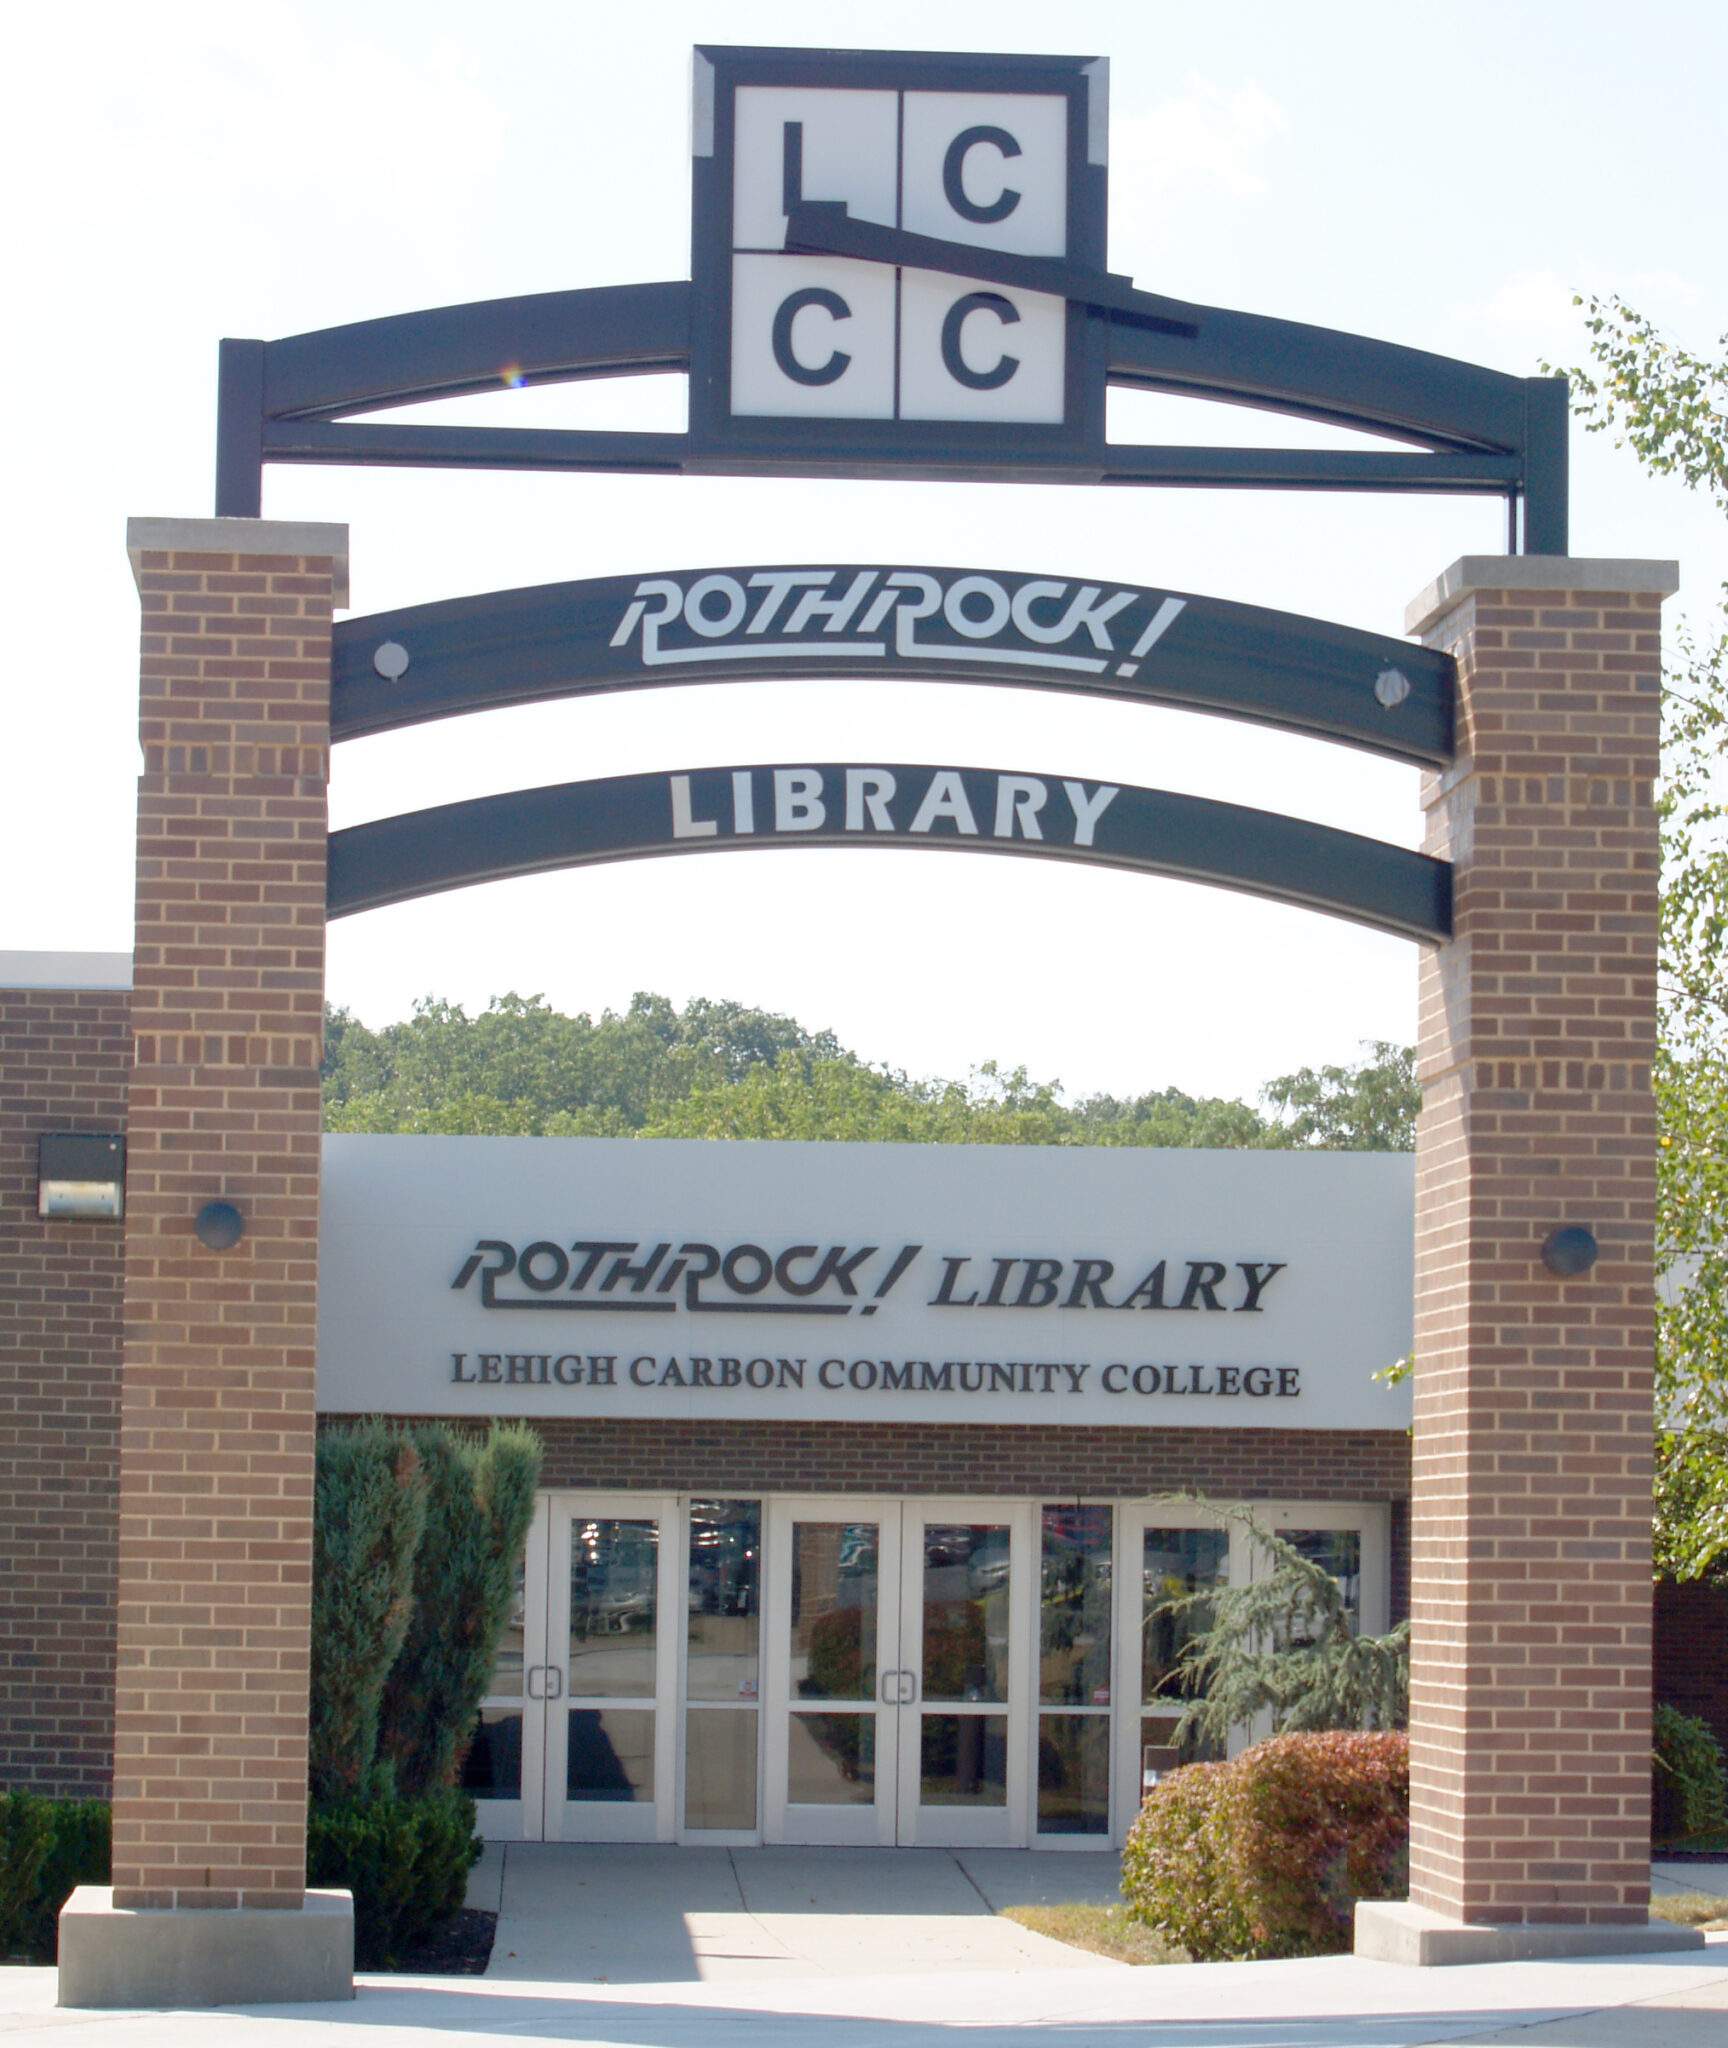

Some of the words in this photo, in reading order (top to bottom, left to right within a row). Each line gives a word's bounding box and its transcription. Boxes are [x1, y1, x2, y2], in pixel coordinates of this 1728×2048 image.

[783, 121, 848, 217] L
[942, 125, 1023, 224] C
[772, 287, 852, 386] C
[941, 292, 1021, 391] C
[669, 768, 1120, 847] LIBRARY
[926, 1256, 1288, 1312] LIBRARY
[450, 1353, 618, 1386] LEHIGH
[628, 1356, 807, 1389] CARBON
[818, 1359, 1091, 1394] COMMUNITY
[1101, 1364, 1301, 1398] COLLEGE
